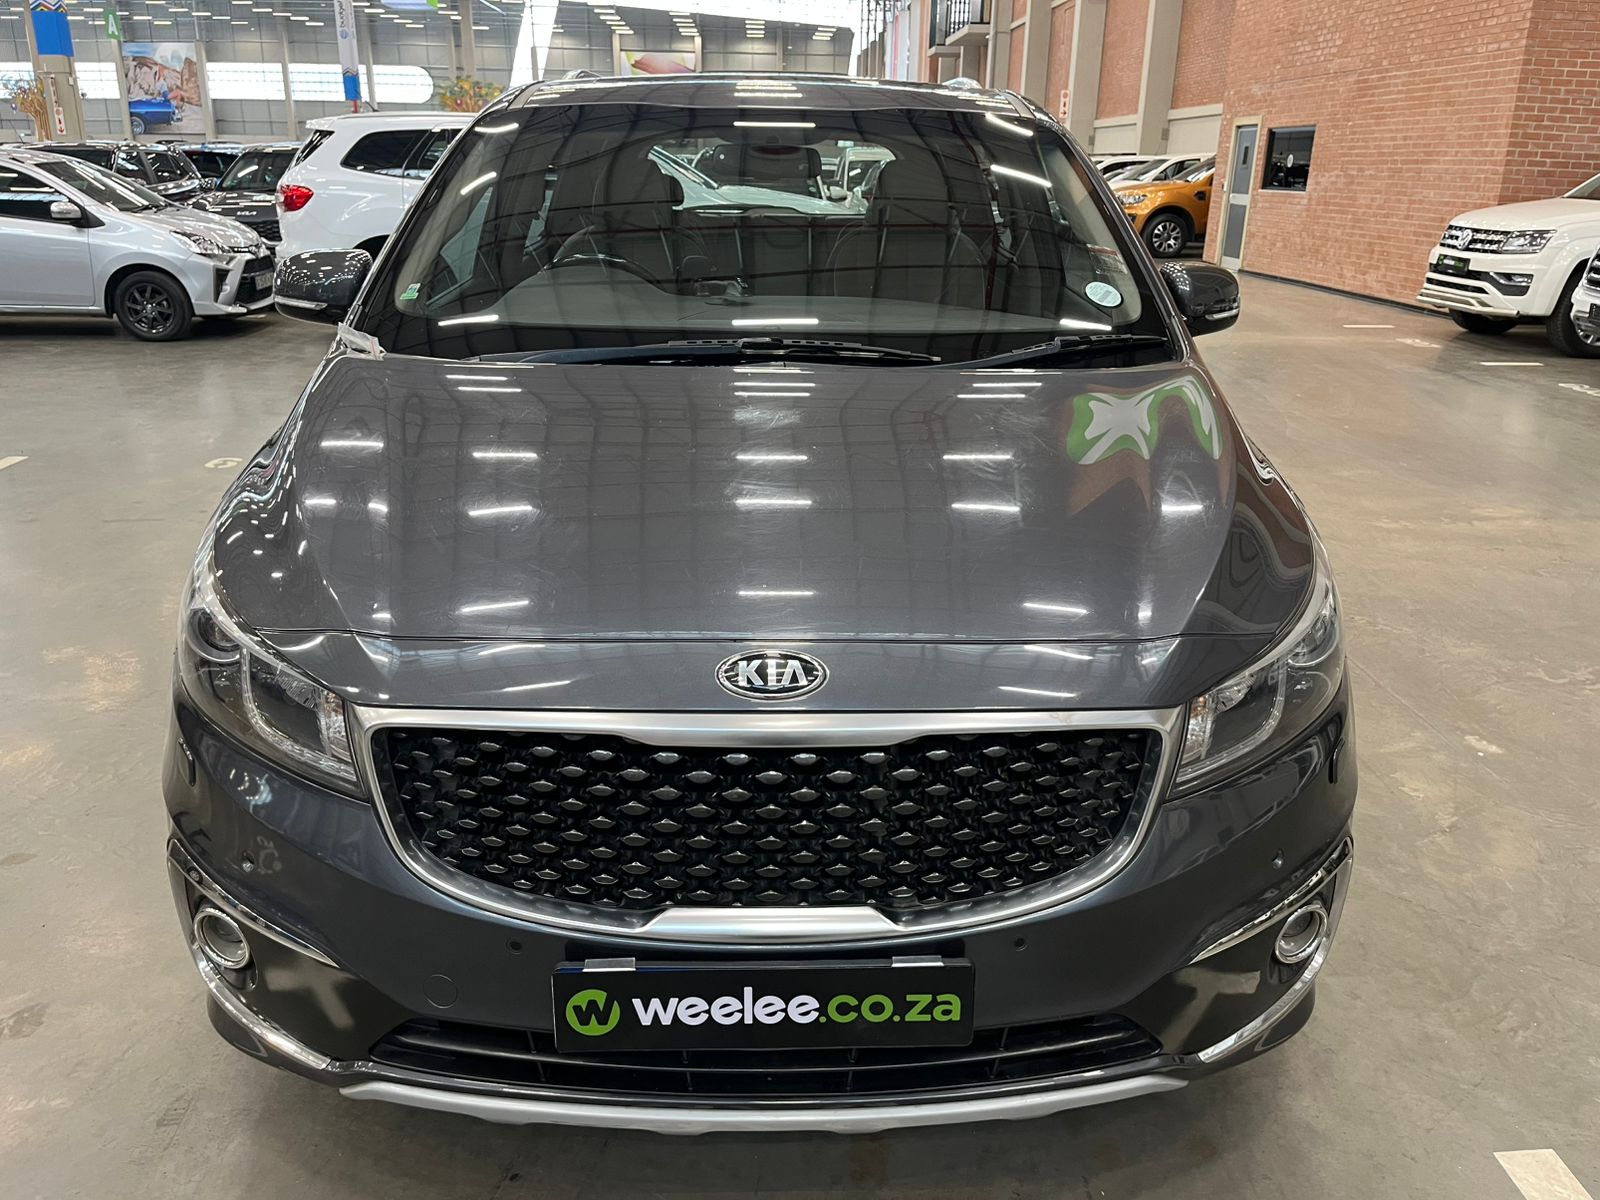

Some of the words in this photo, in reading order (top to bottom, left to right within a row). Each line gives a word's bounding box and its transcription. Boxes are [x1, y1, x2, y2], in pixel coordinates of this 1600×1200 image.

[108, 14, 118, 35] A
[736, 659, 808, 687] KIA
[631, 986, 962, 1026] weelee.co.za
